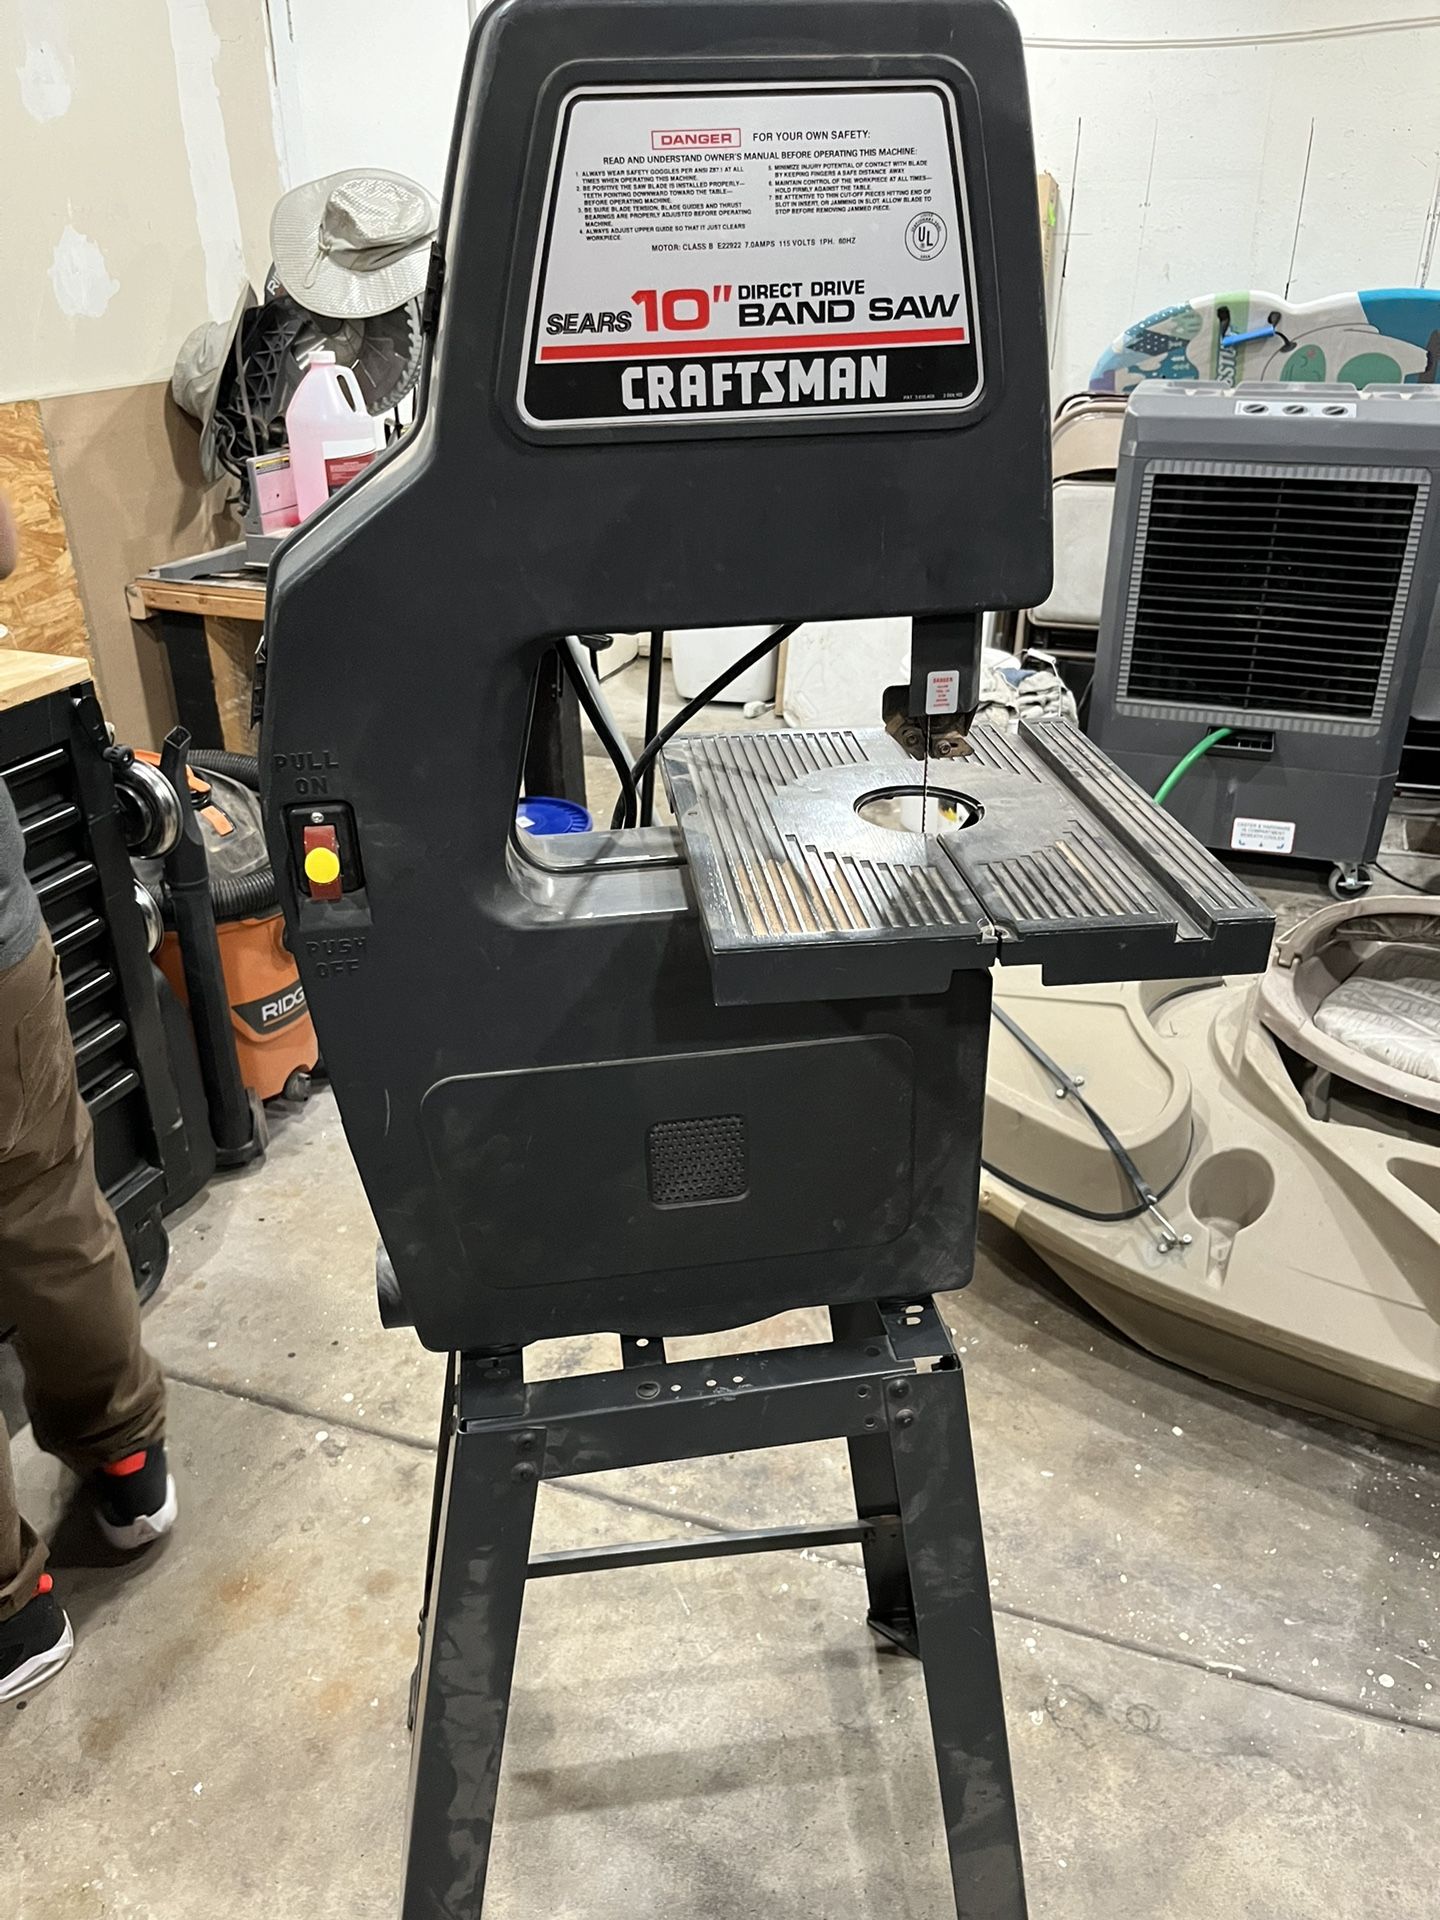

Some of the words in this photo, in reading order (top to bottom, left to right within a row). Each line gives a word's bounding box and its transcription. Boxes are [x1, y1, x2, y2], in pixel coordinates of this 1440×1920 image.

[661, 133, 732, 145] DANGER
[753, 132, 773, 141] FOR
[776, 131, 802, 140] YOUR
[806, 131, 828, 140] OWN
[831, 129, 873, 139] SAFETY:
[603, 156, 625, 164] READ
[627, 156, 645, 164] AND
[647, 154, 702, 163] UNDERSTAND
[704, 153, 741, 161] OWNER'S
[744, 151, 779, 160] MANUAL
[781, 150, 811, 159] BEFORE
[814, 149, 858, 158] OPERATING
[860, 148, 876, 156] THIS
[652, 243, 680, 251] MOTOR:
[683, 242, 706, 250] CLASS
[717, 241, 741, 249] E22922
[779, 239, 790, 247] 115
[792, 238, 815, 246] VOLTS
[738, 283, 802, 300] DIRECT
[811, 280, 865, 297] DRIVE
[546, 311, 632, 335] SEARS
[631, 285, 732, 332] 10"
[739, 300, 855, 327] BAND
[869, 294, 960, 321] SAW
[620, 355, 887, 411] CRAFTSMAN
[273, 750, 339, 771] PULL
[296, 776, 328, 795] ON
[306, 936, 366, 957] PUSH
[316, 959, 359, 978] OFF
[261, 986, 306, 1021] RIDG
